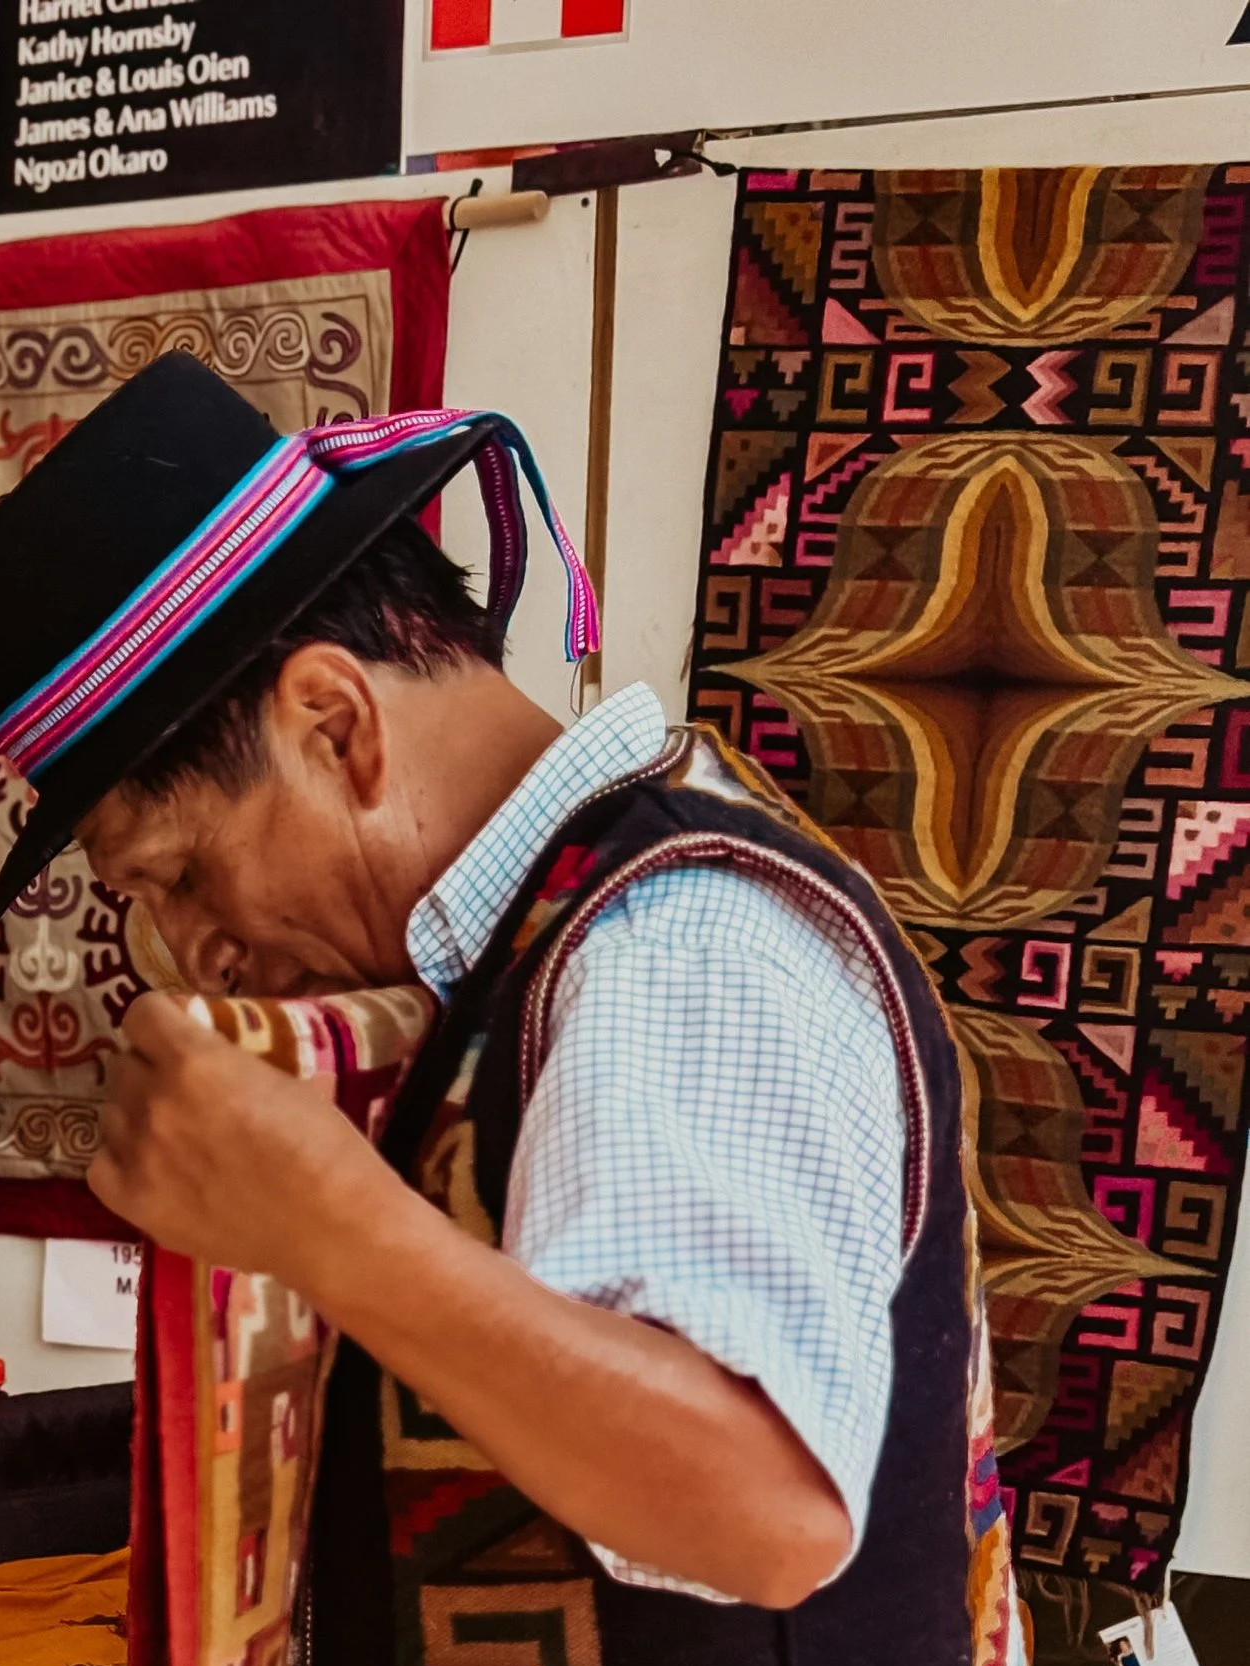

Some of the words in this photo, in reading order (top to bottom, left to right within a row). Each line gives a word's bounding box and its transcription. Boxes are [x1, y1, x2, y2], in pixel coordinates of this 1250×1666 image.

[18, 29, 88, 67] Kathy
[91, 14, 196, 56] Hornsby
[16, 72, 92, 106] Janice
[95, 66, 115, 96] &
[119, 58, 184, 93] Louis
[188, 52, 249, 84] Oien
[14, 117, 90, 147] James
[94, 107, 114, 137] &
[117, 104, 166, 134] Ana
[169, 92, 277, 128] Williams
[14, 150, 85, 193] Ngozi
[89, 144, 167, 178] Okaro
